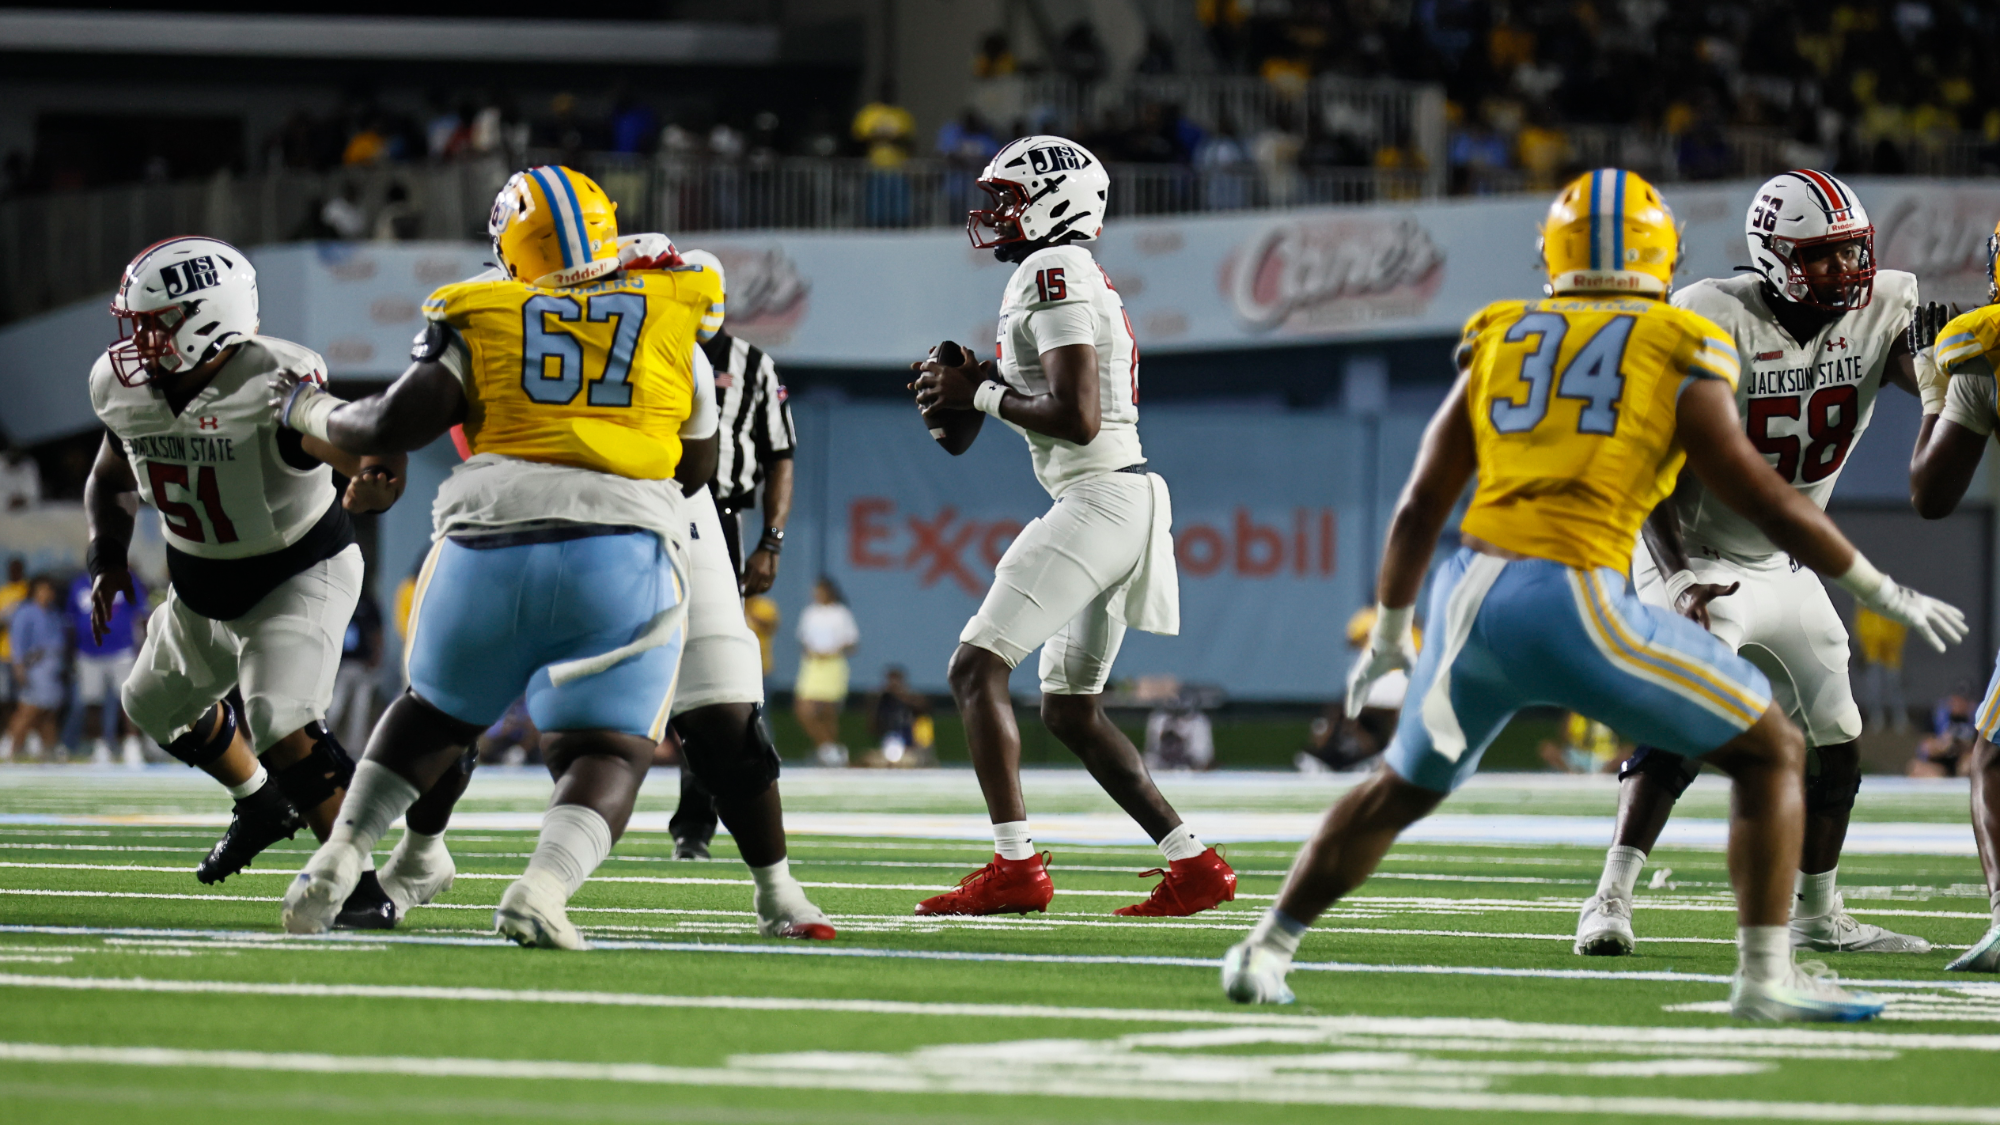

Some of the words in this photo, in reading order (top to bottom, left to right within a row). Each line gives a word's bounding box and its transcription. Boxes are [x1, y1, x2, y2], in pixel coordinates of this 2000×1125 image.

[1036, 267, 1068, 303] 15
[521, 291, 647, 408] 67
[1489, 311, 1637, 437] 34
[1748, 366, 1815, 395] JACKSON
[1819, 355, 1863, 386] STATE
[190, 437, 236, 462] STATE
[1746, 384, 1859, 484] 58
[146, 460, 240, 544] 51
